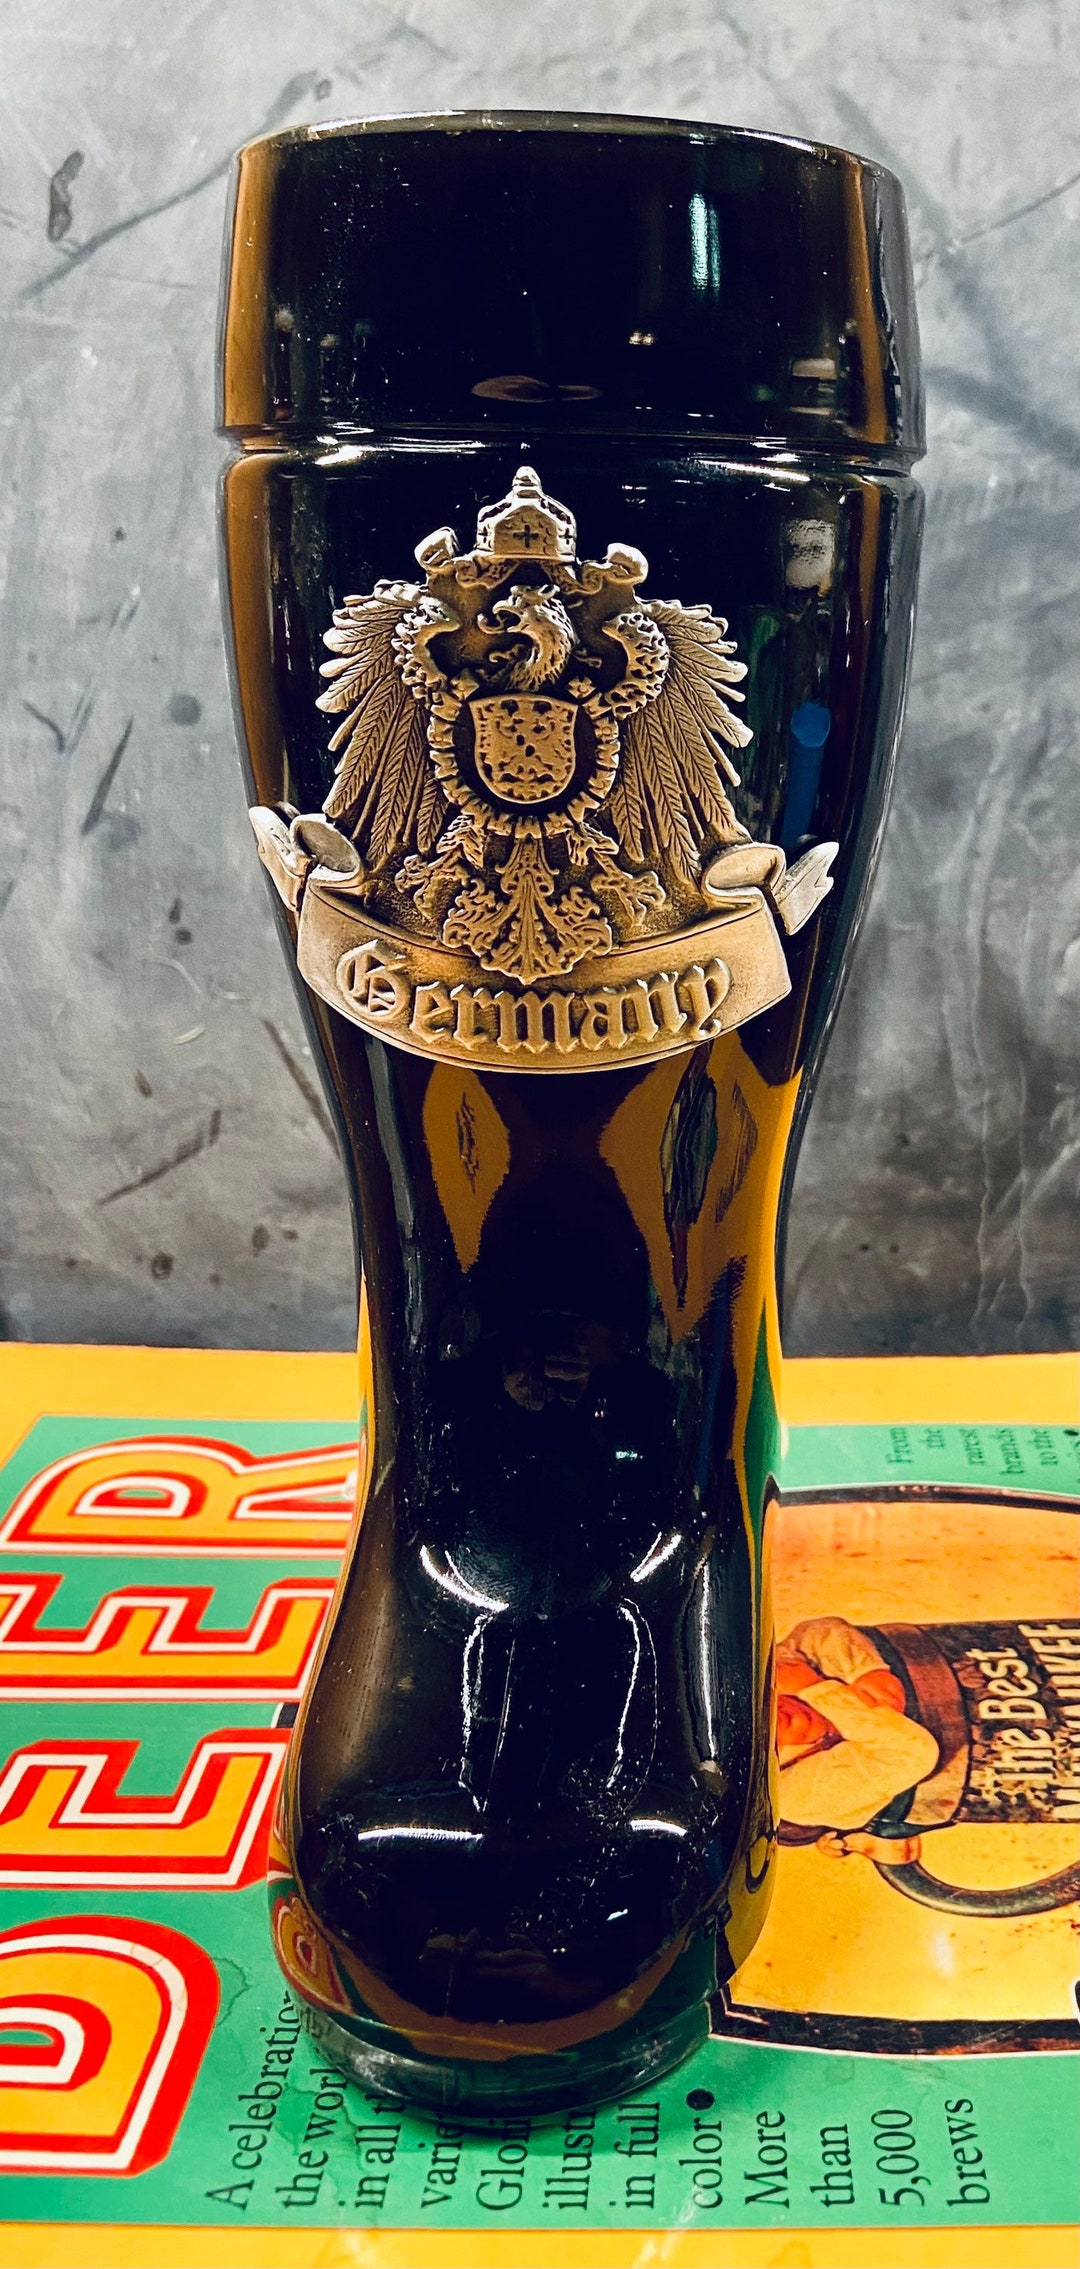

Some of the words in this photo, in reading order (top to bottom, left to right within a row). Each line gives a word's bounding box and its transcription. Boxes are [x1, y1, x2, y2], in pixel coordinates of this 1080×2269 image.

[334, 938, 732, 1053] Germany
[884, 1426, 913, 1464] From
[918, 1427, 946, 1448] the
[964, 1645, 1048, 1719] Best
[969, 1726, 1056, 1810] The
[227, 1988, 302, 2169] celebratio
[274, 2148, 330, 2208] the
[308, 2061, 350, 2142] worl
[354, 2121, 402, 2164] all
[417, 2114, 464, 2208] varie
[612, 2099, 661, 2158] full
[677, 2115, 724, 2209] color
[743, 2108, 790, 2208] More
[808, 2122, 856, 2207] than
[870, 2107, 933, 2206] 5,000
[943, 2096, 992, 2206] brews
[203, 2177, 256, 2210] A
[337, 2171, 391, 2209] in
[608, 2172, 657, 2208] in
